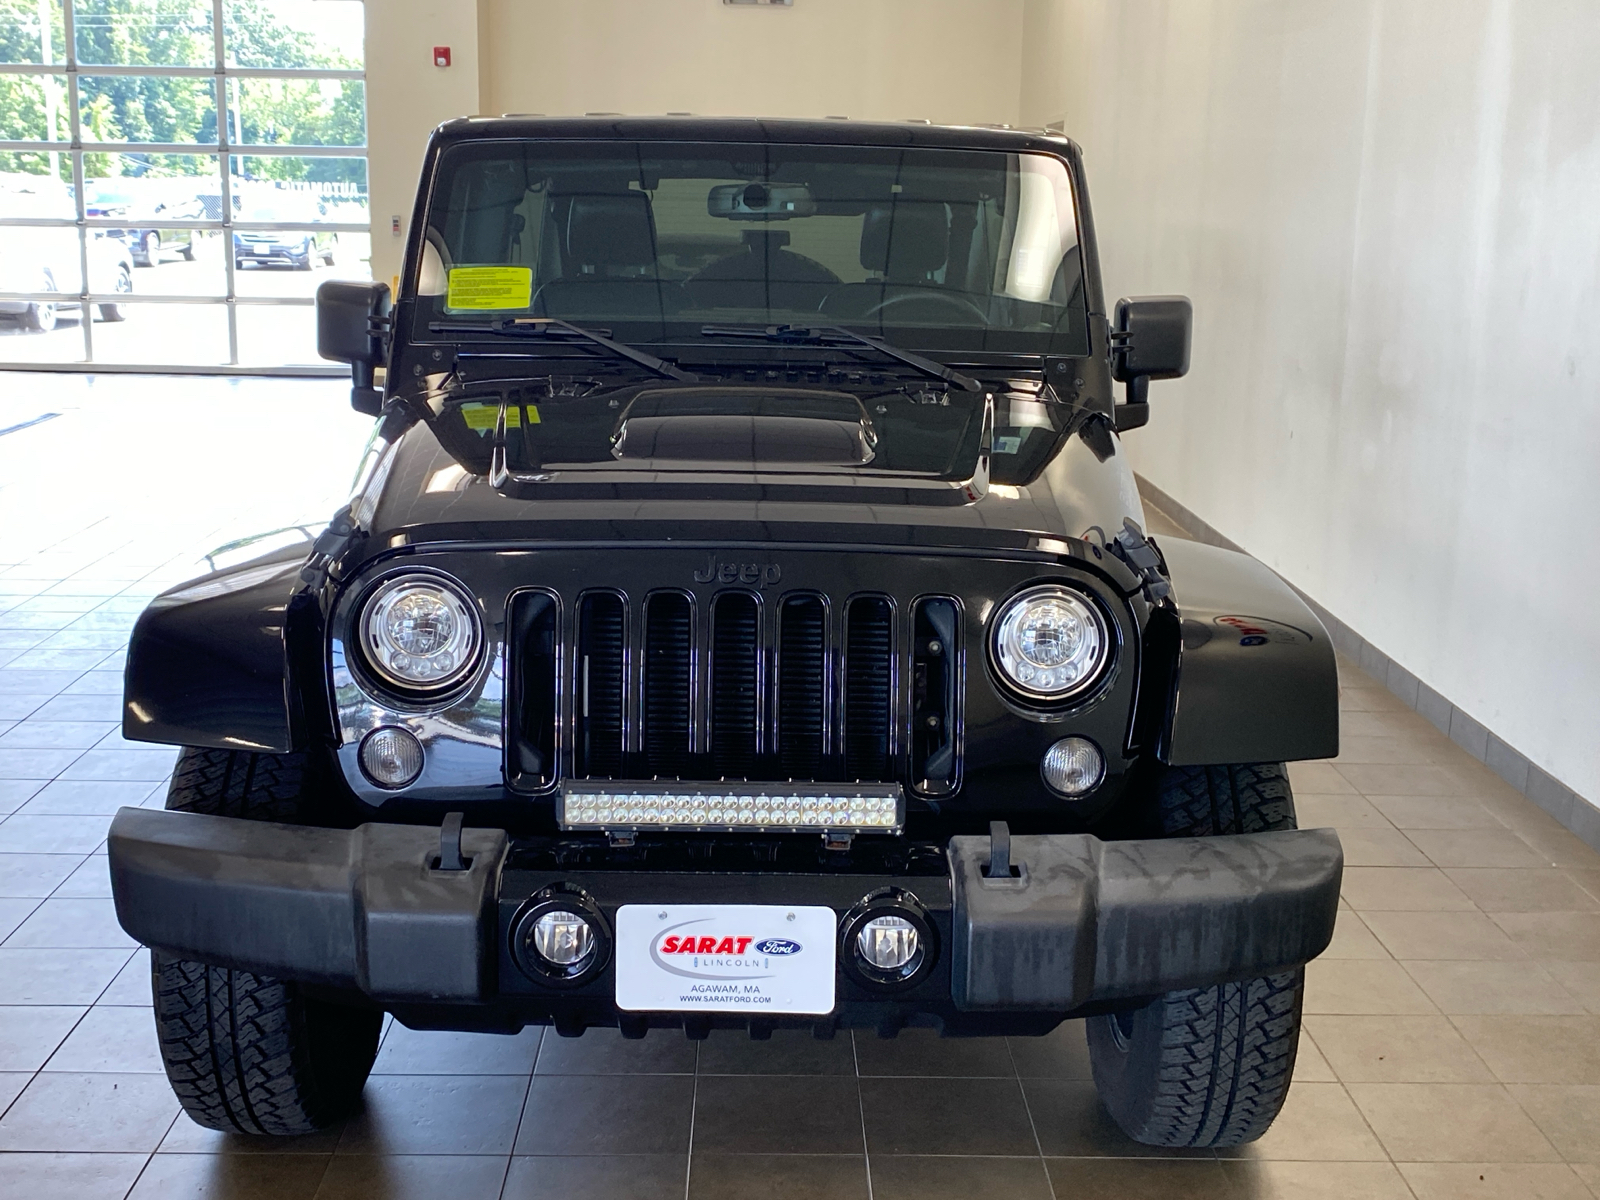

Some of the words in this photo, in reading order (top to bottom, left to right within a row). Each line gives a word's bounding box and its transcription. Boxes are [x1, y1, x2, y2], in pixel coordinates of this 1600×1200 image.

[693, 555, 781, 591] Jeep
[661, 935, 754, 955] SARAT
[762, 940, 795, 955] Ford
[703, 959, 759, 967] LINCOLN
[690, 984, 741, 994] AGAWAM,
[744, 985, 761, 994] MA
[679, 995, 772, 1004] WWW.SARATFORD.COM
